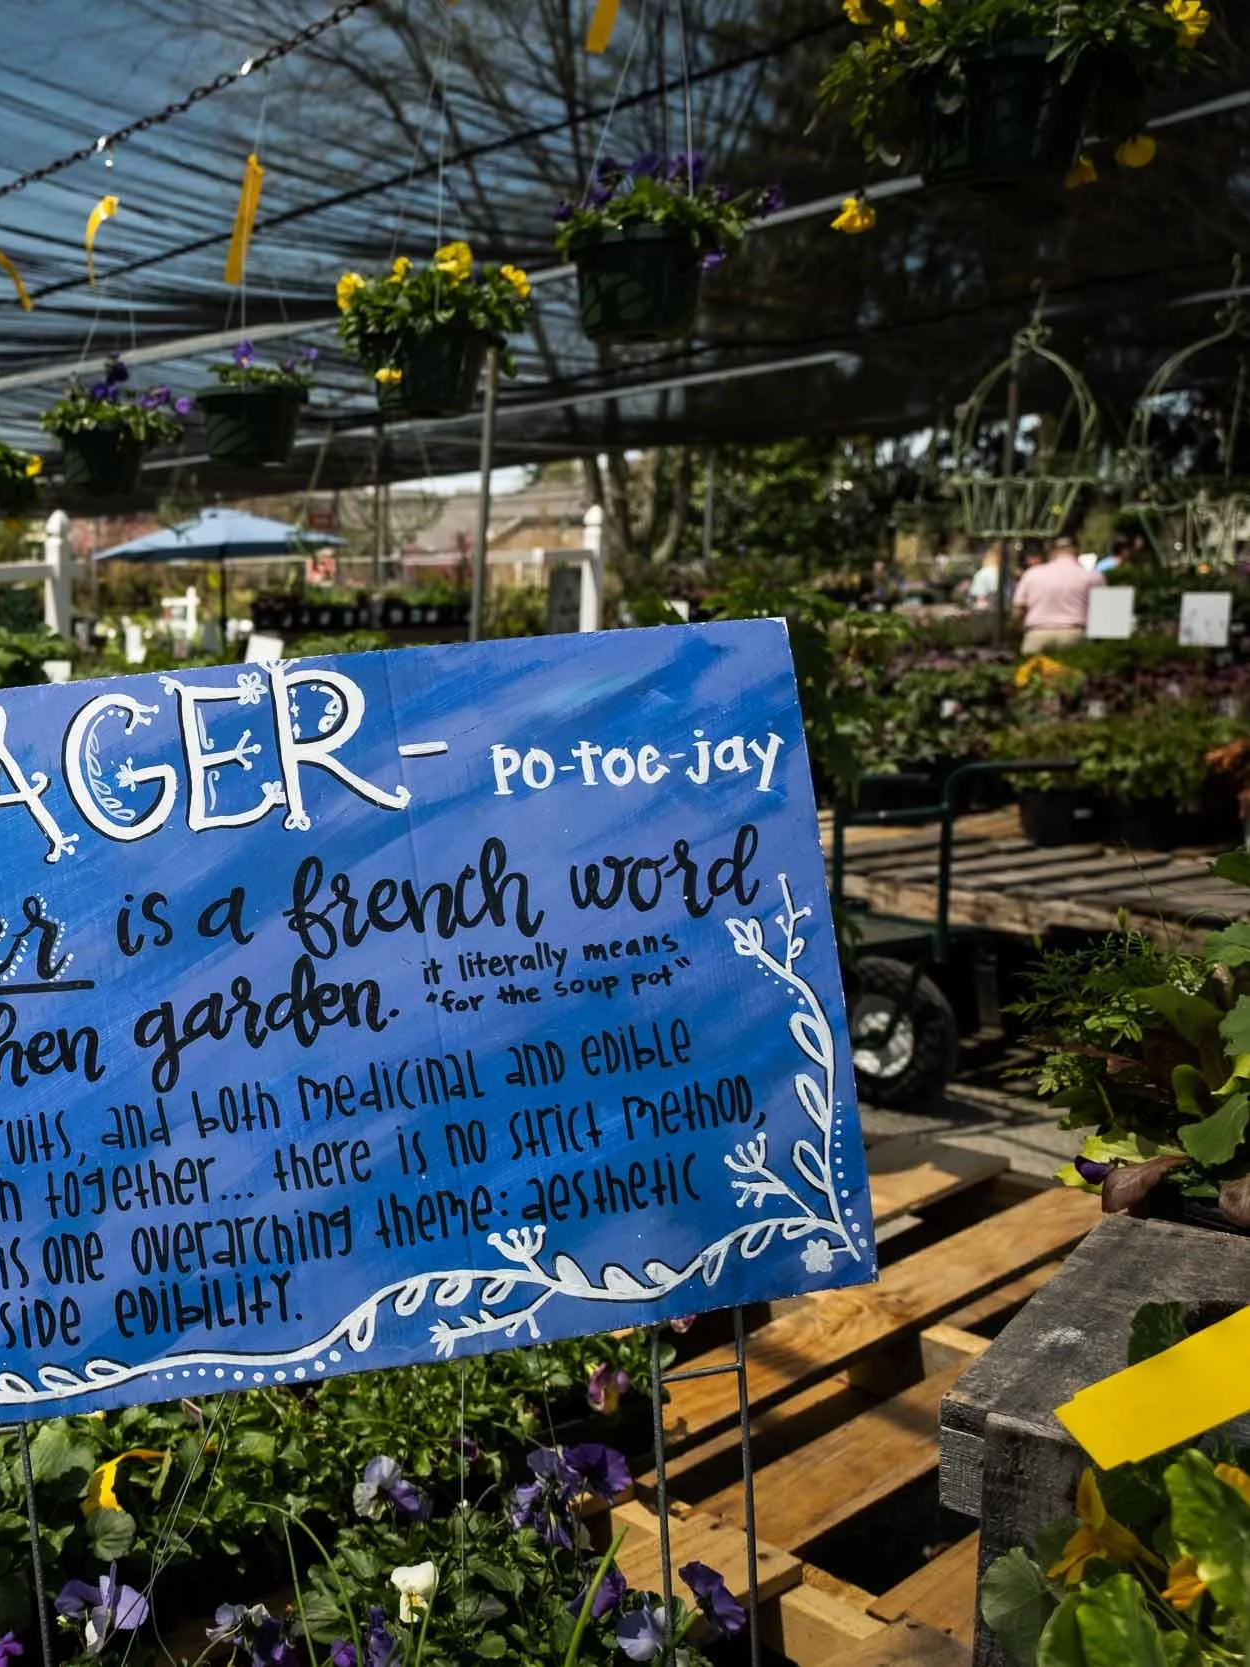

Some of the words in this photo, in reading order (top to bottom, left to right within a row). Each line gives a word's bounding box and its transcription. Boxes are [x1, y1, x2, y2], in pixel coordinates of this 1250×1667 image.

[117, 892, 173, 957] is
[197, 887, 254, 945] a
[283, 837, 546, 959] french
[570, 824, 760, 919] word
[421, 957, 443, 985] it
[457, 941, 568, 981] literally
[581, 932, 679, 962] means
[496, 983, 542, 1005] the
[553, 974, 620, 999] soup
[134, 953, 402, 1093] garden.
[101, 1097, 171, 1149] and
[191, 1083, 280, 1138] both
[298, 1050, 485, 1121] medicinal
[273, 1140, 371, 1191] there
[398, 1131, 427, 1174] is
[445, 1119, 487, 1167] no
[509, 1102, 602, 1161] strict
[42, 1231, 104, 1285] one
[131, 1206, 352, 1275] overarching
[521, 1153, 700, 1225] aesthetic
